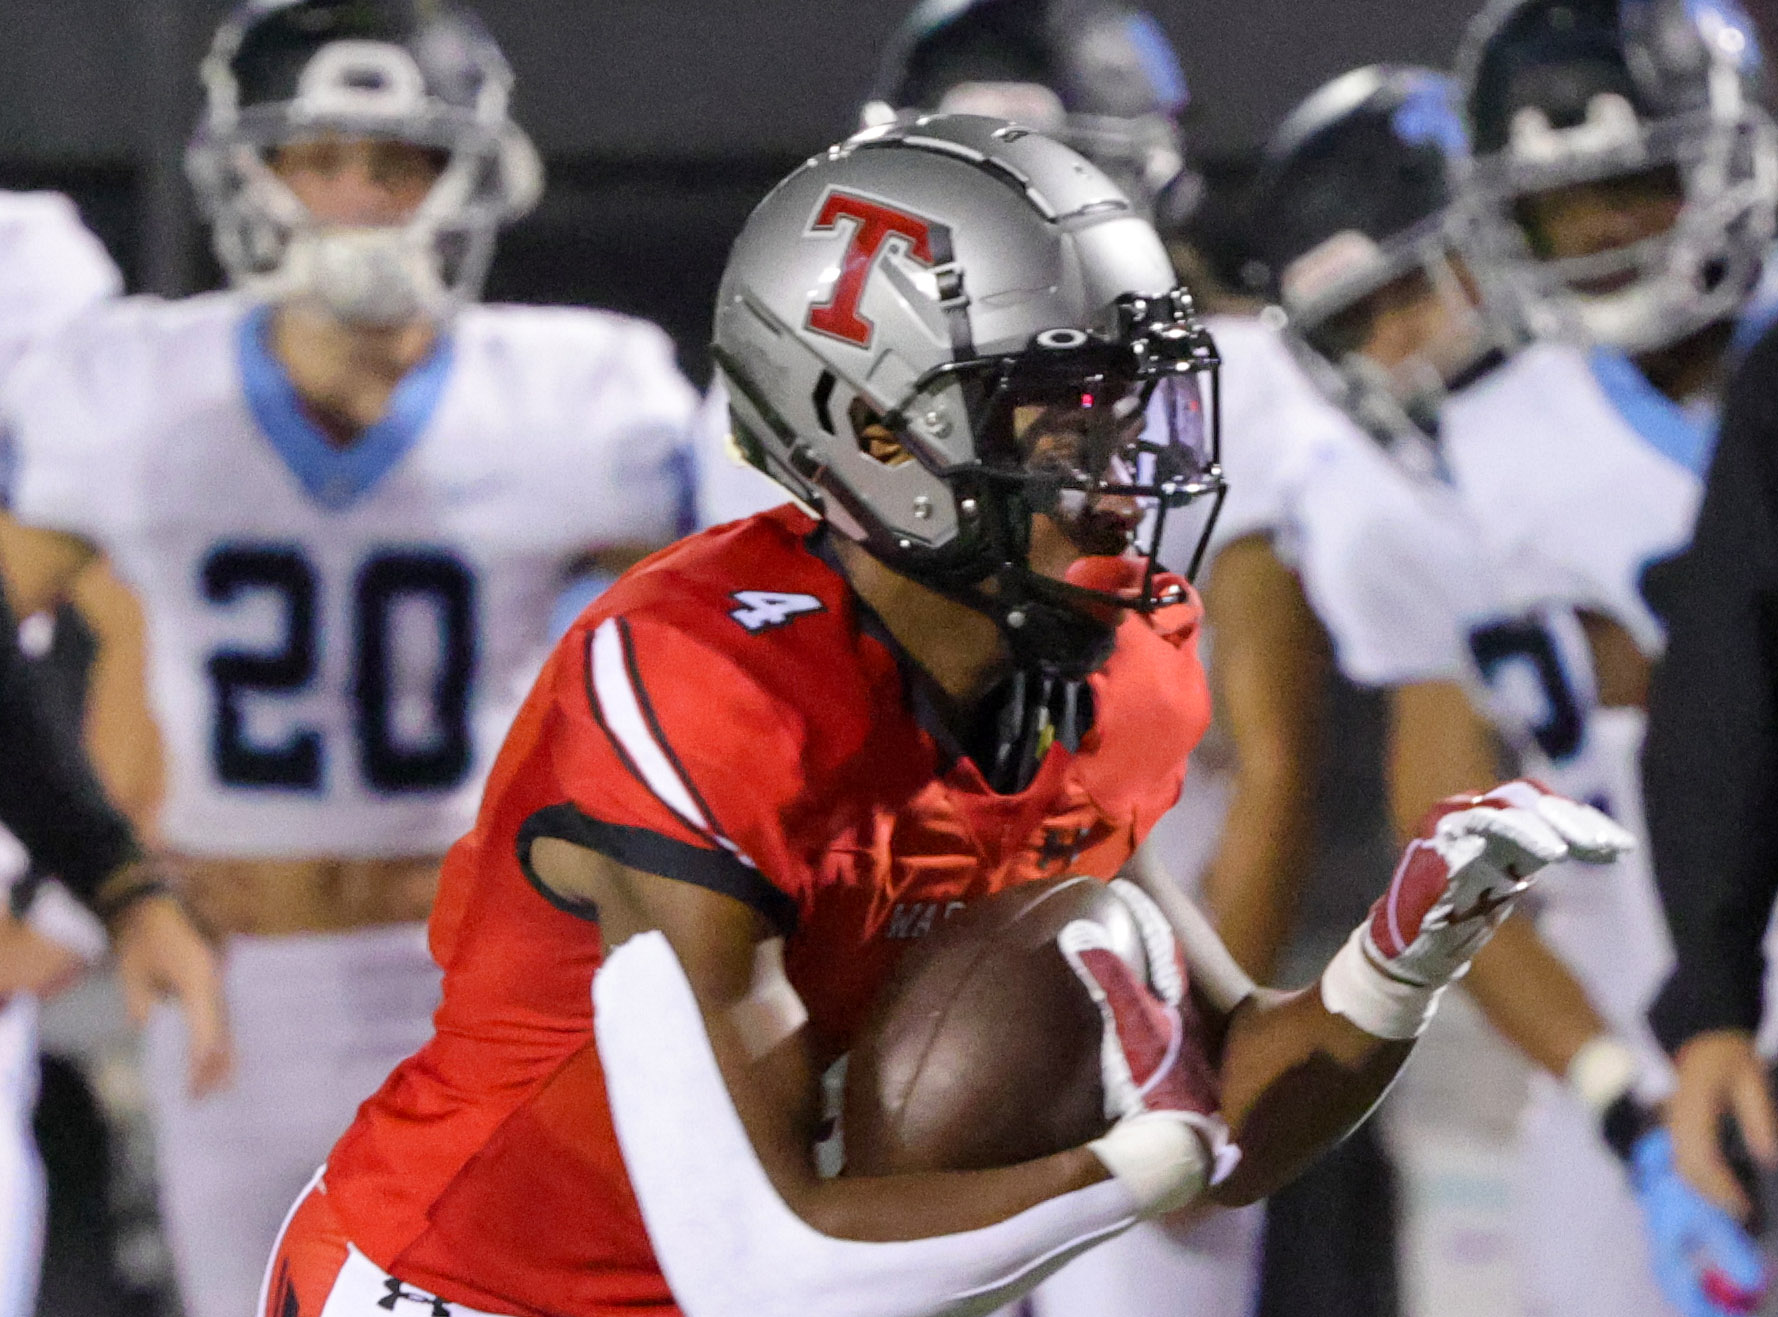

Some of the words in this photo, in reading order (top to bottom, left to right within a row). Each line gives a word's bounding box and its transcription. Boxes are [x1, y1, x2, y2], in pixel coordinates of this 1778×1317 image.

[803, 183, 954, 349] T
[202, 541, 478, 795] 20
[729, 589, 823, 633] 4
